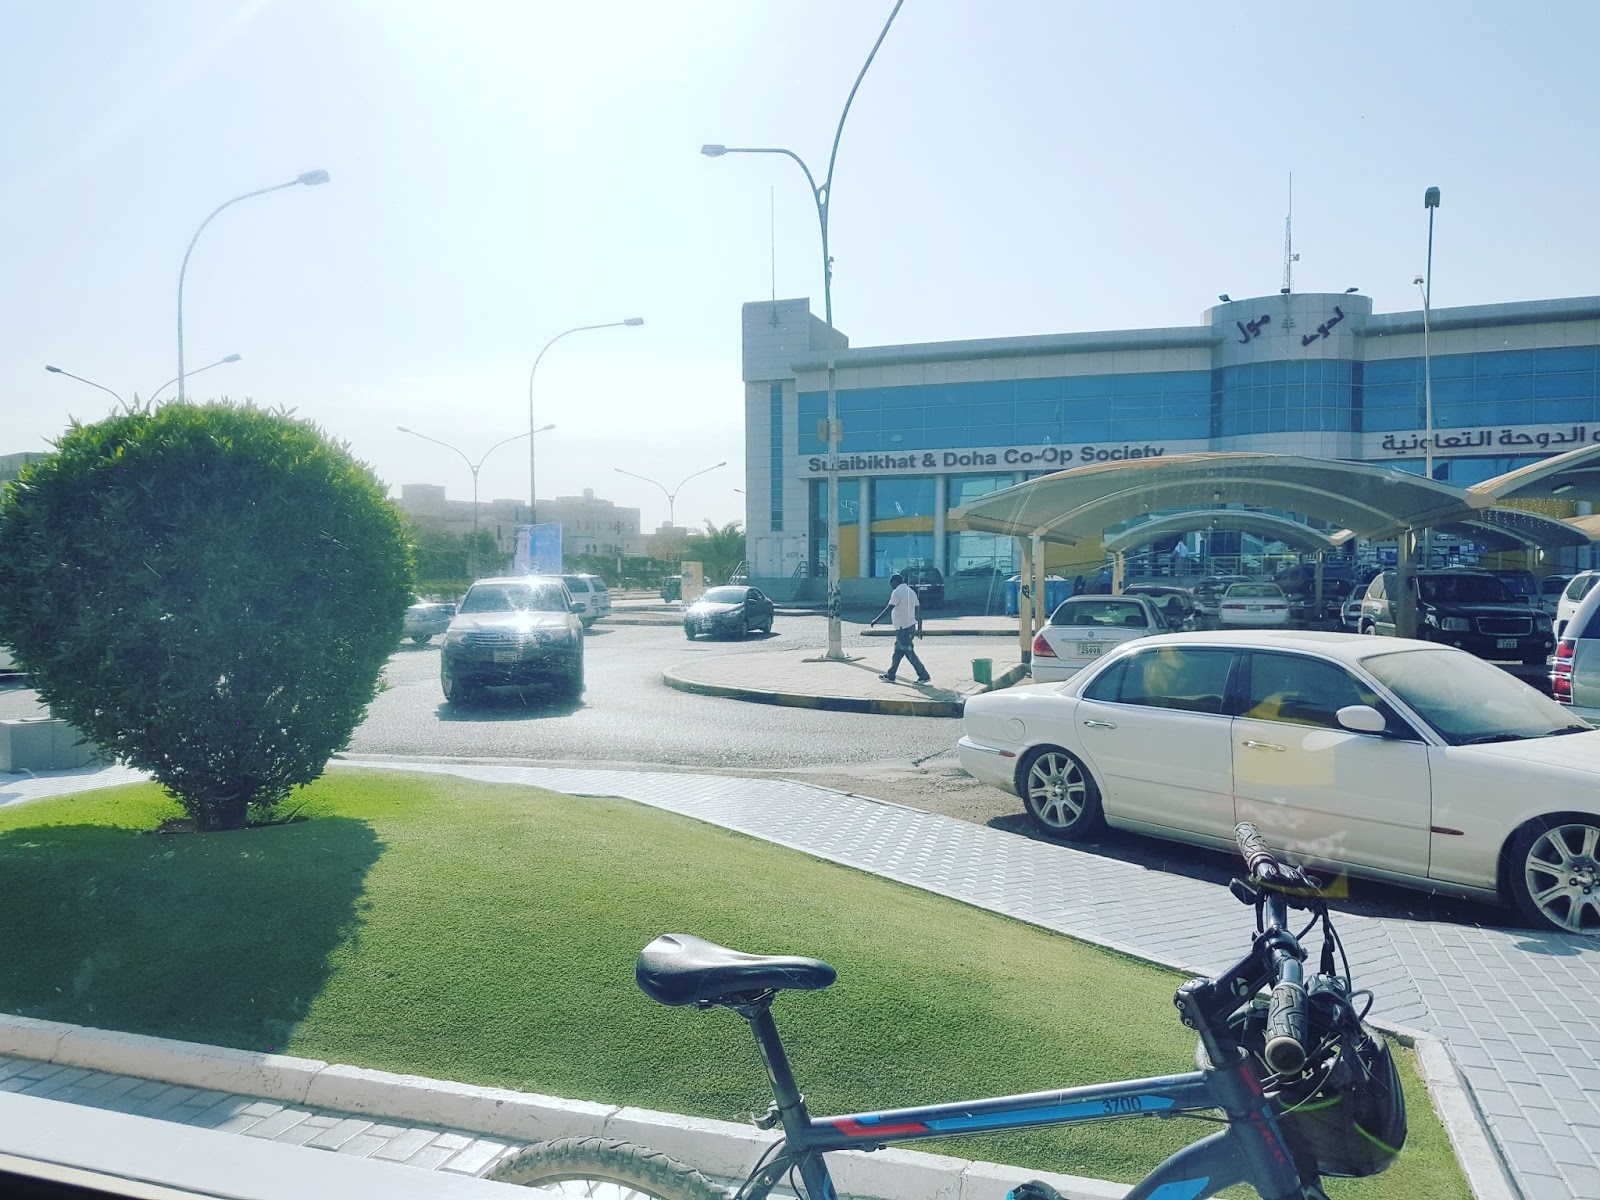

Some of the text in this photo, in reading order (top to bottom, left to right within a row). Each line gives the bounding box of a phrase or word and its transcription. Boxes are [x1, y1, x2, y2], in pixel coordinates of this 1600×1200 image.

[1499, 426, 1585, 448] الدوحة
[808, 454, 916, 472] Suaibikhat
[921, 452, 937, 468] &
[943, 450, 997, 467] Doha
[1003, 447, 1073, 465] Co-Op
[1102, 1095, 1142, 1114] 3700
